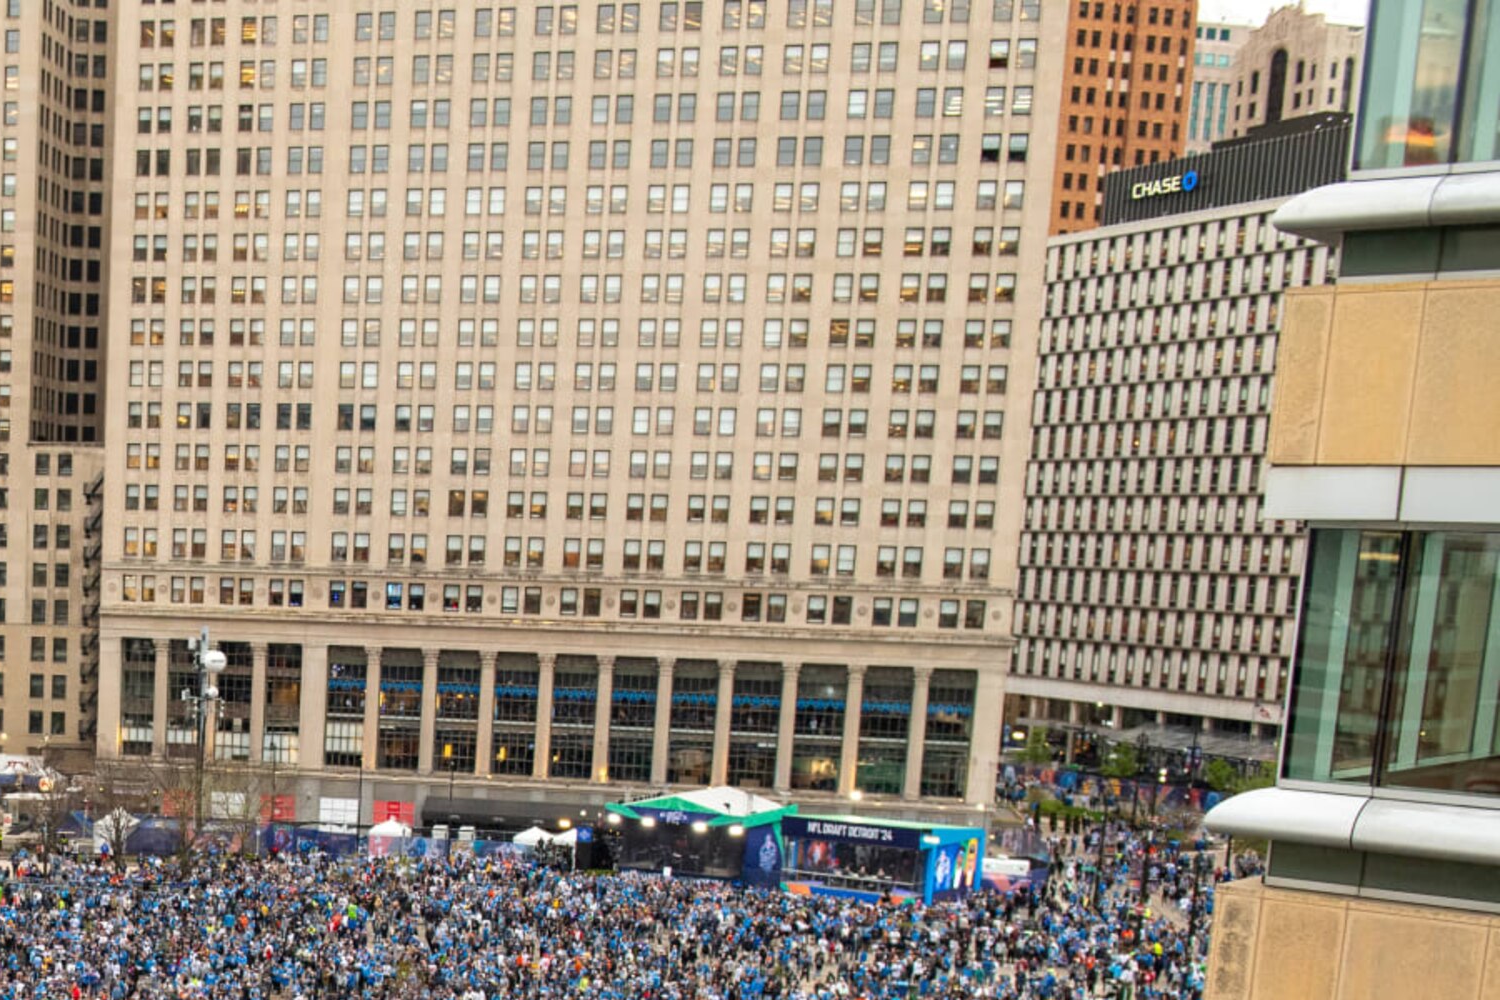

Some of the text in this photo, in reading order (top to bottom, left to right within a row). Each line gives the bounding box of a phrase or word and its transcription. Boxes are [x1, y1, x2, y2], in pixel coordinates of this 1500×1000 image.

[1132, 175, 1182, 200] CHASE
[807, 821, 821, 834] NFL
[823, 823, 847, 838] DRAFT
[848, 826, 880, 840] DETROIT
